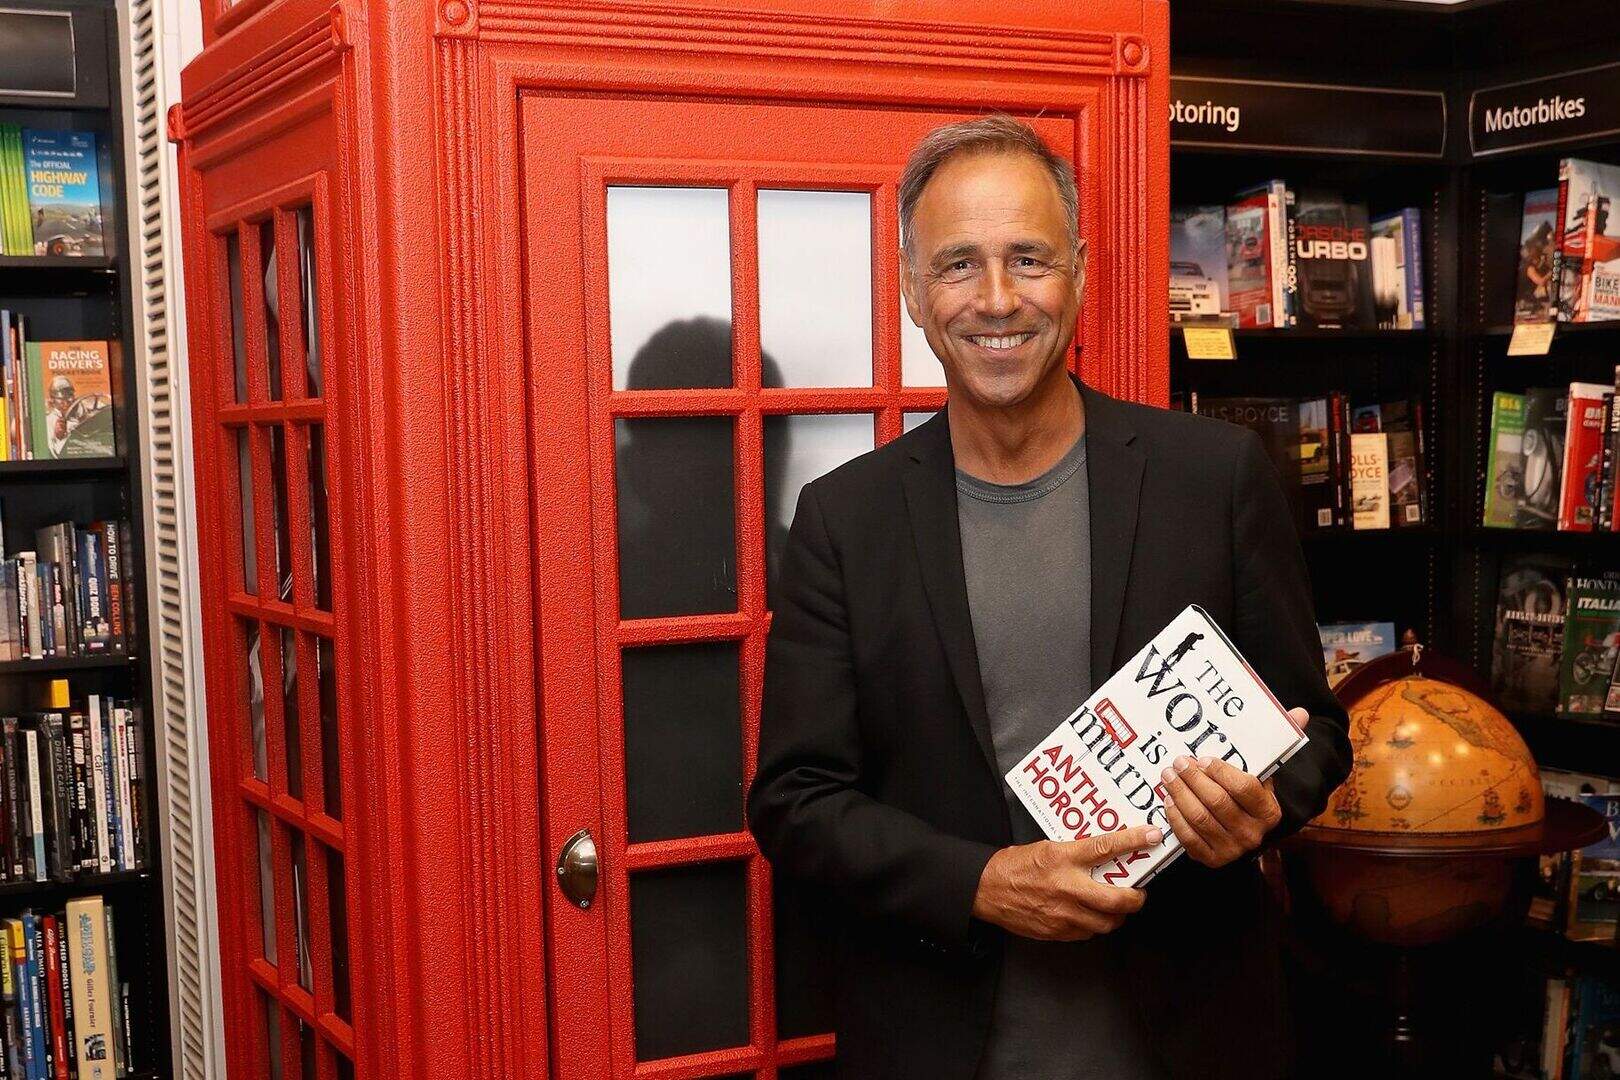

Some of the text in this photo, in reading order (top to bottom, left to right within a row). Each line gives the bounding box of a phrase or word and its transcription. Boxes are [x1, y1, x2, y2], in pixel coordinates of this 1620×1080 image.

[1169, 100, 1240, 132] toring
[1484, 95, 1586, 133] Motorbikes
[31, 171, 87, 186] HIGHWAY
[32, 184, 64, 197] CODE
[1297, 224, 1365, 242] ORSCHE
[1297, 240, 1367, 260] URBO
[48, 359, 104, 369] DRIVER'S
[51, 351, 99, 360] RACING
[1351, 467, 1381, 479] OYCE
[89, 577, 98, 595] QUIZ
[107, 524, 121, 635] HOW TO DRIVE BEN COLLINS
[90, 596, 100, 617] BOOK
[1138, 730, 1168, 766] is
[54, 740, 65, 798] DREAM CARS
[95, 755, 104, 774] car
[76, 782, 86, 810] COVERS
[1042, 744, 1151, 866] ANTHOY
[35, 931, 43, 948] ALFA
[57, 922, 65, 939] ALVIS
[59, 940, 67, 961] SPEED
[37, 949, 45, 978] ROMEO
[61, 962, 69, 989] MODELS
[86, 978, 94, 997] Gilles
[87, 999, 96, 1028] Fournier
